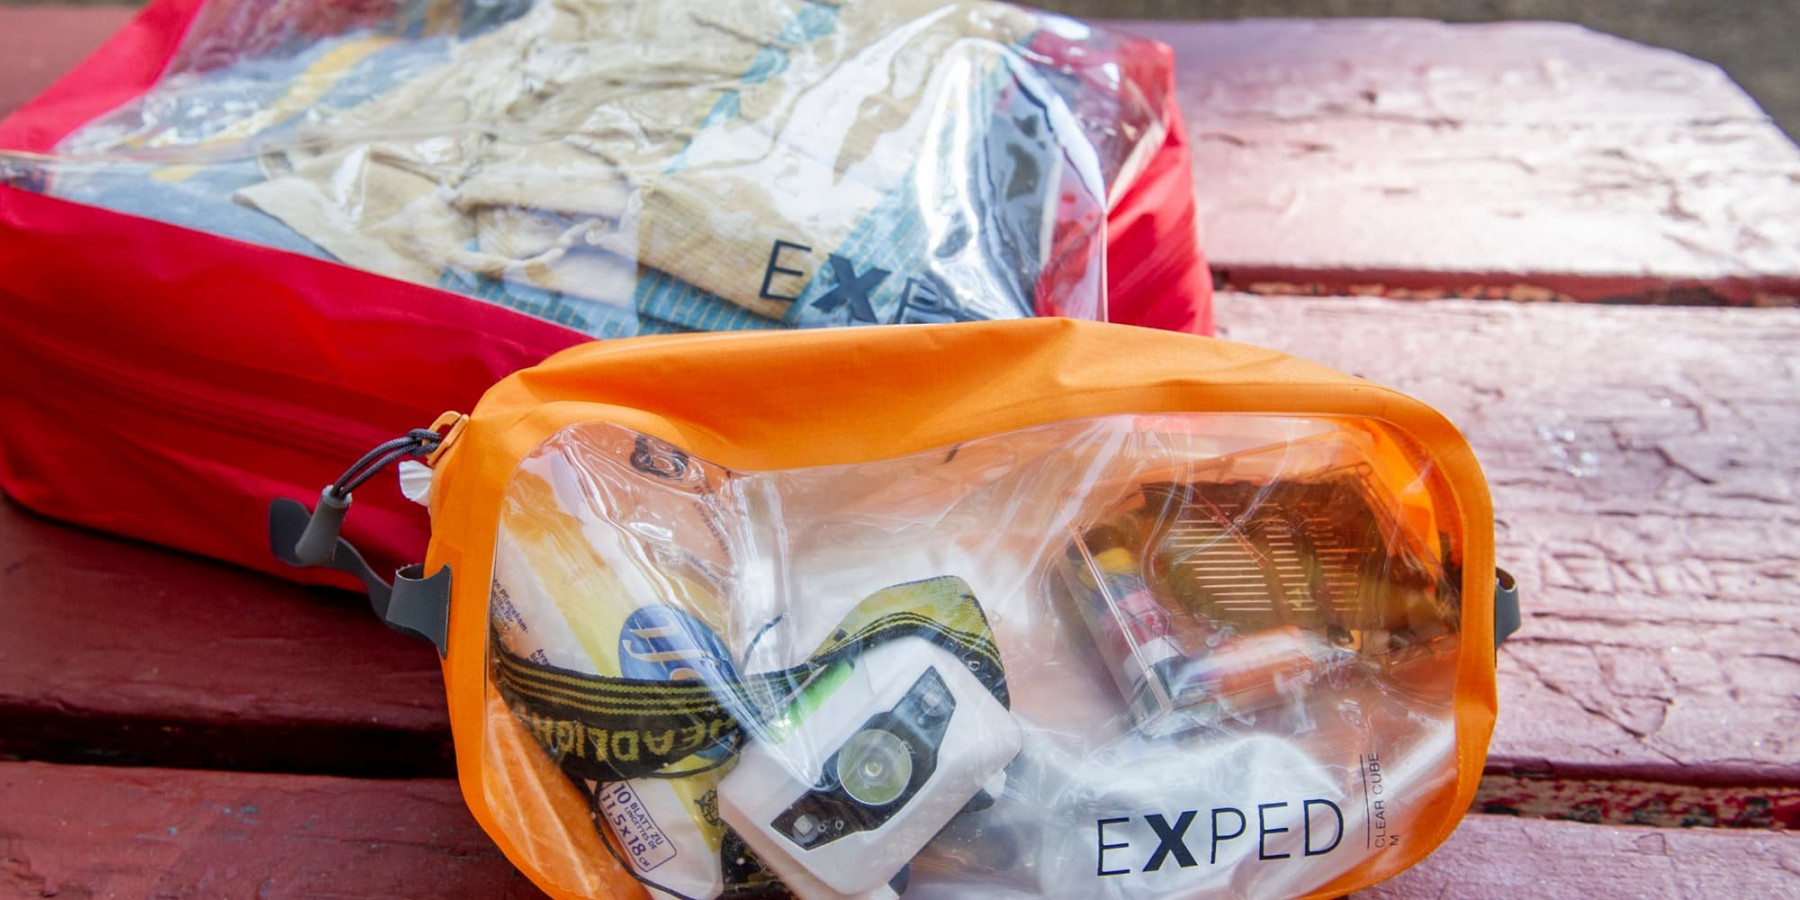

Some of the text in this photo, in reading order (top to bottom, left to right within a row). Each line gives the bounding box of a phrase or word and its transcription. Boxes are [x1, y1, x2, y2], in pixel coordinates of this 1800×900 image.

[759, 239, 946, 324] EXP
[613, 783, 664, 845] 10 BLATT ZU
[624, 806, 658, 850] LINGETTES DE
[1368, 752, 1387, 848] CLEAR CUBE
[1097, 798, 1345, 877] EXPED
[1389, 834, 1400, 846] M
